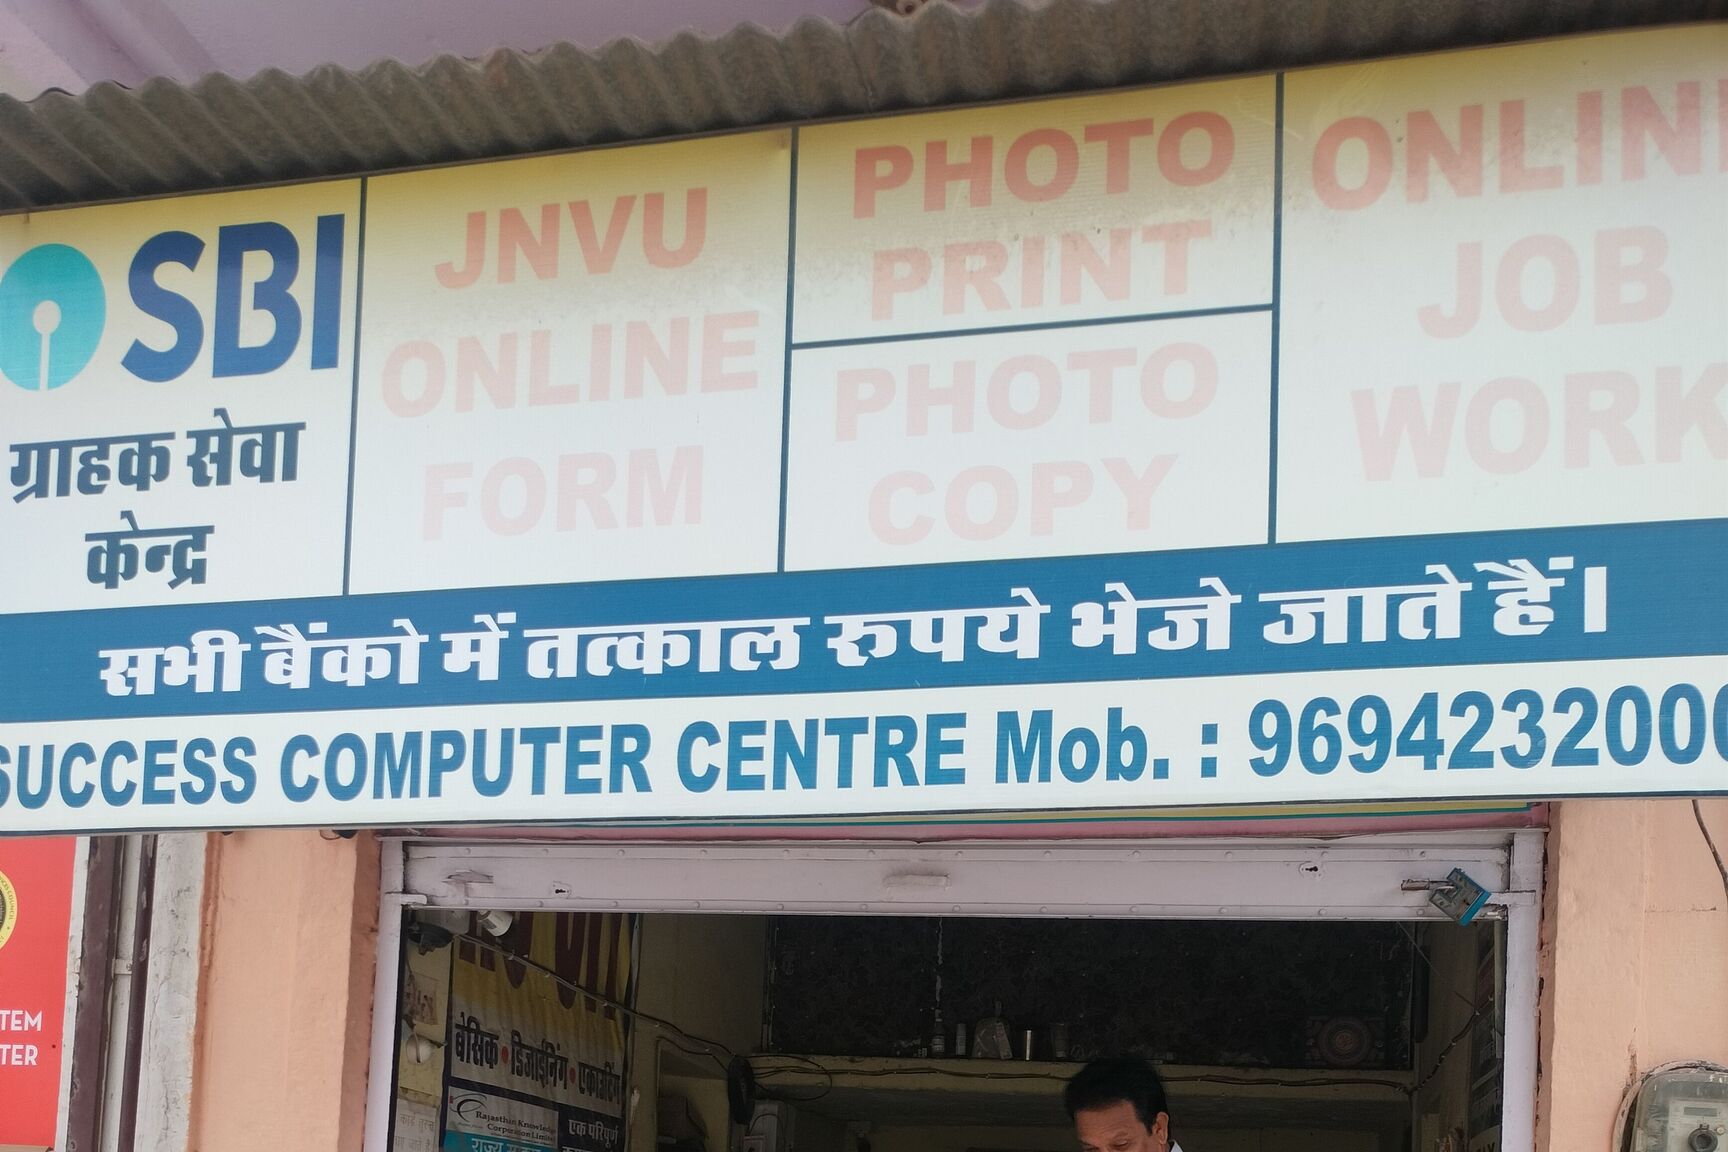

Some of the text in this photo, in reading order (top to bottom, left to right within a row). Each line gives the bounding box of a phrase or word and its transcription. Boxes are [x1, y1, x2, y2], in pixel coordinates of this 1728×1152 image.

[852, 112, 1235, 219] PHOTO
[1311, 78, 1728, 210] ONLIN
[435, 188, 708, 290] JNVU
[870, 220, 1212, 323] PRINT
[1417, 226, 1673, 338] JOB
[121, 214, 345, 382] SBI
[381, 311, 760, 417] ONLINE
[833, 342, 1220, 442] PHOTO
[9, 408, 306, 503] ग्राहक सेवा
[1350, 362, 1728, 483] WORK
[422, 445, 704, 540] FORM
[867, 454, 1179, 546] COPY
[85, 510, 214, 590] केन्द्र
[99, 629, 250, 698] सभी
[255, 619, 429, 690] बैंको
[441, 612, 517, 682] में
[524, 617, 810, 678] तत्काल
[826, 587, 1051, 668] रुपये
[1071, 577, 1241, 655] भेजे
[1259, 564, 1473, 645] जाते
[0, 736, 257, 810] UCCESS
[279, 725, 652, 802] COMPUTER
[677, 713, 966, 790] CENTRE
[996, 707, 1168, 783] Mob.
